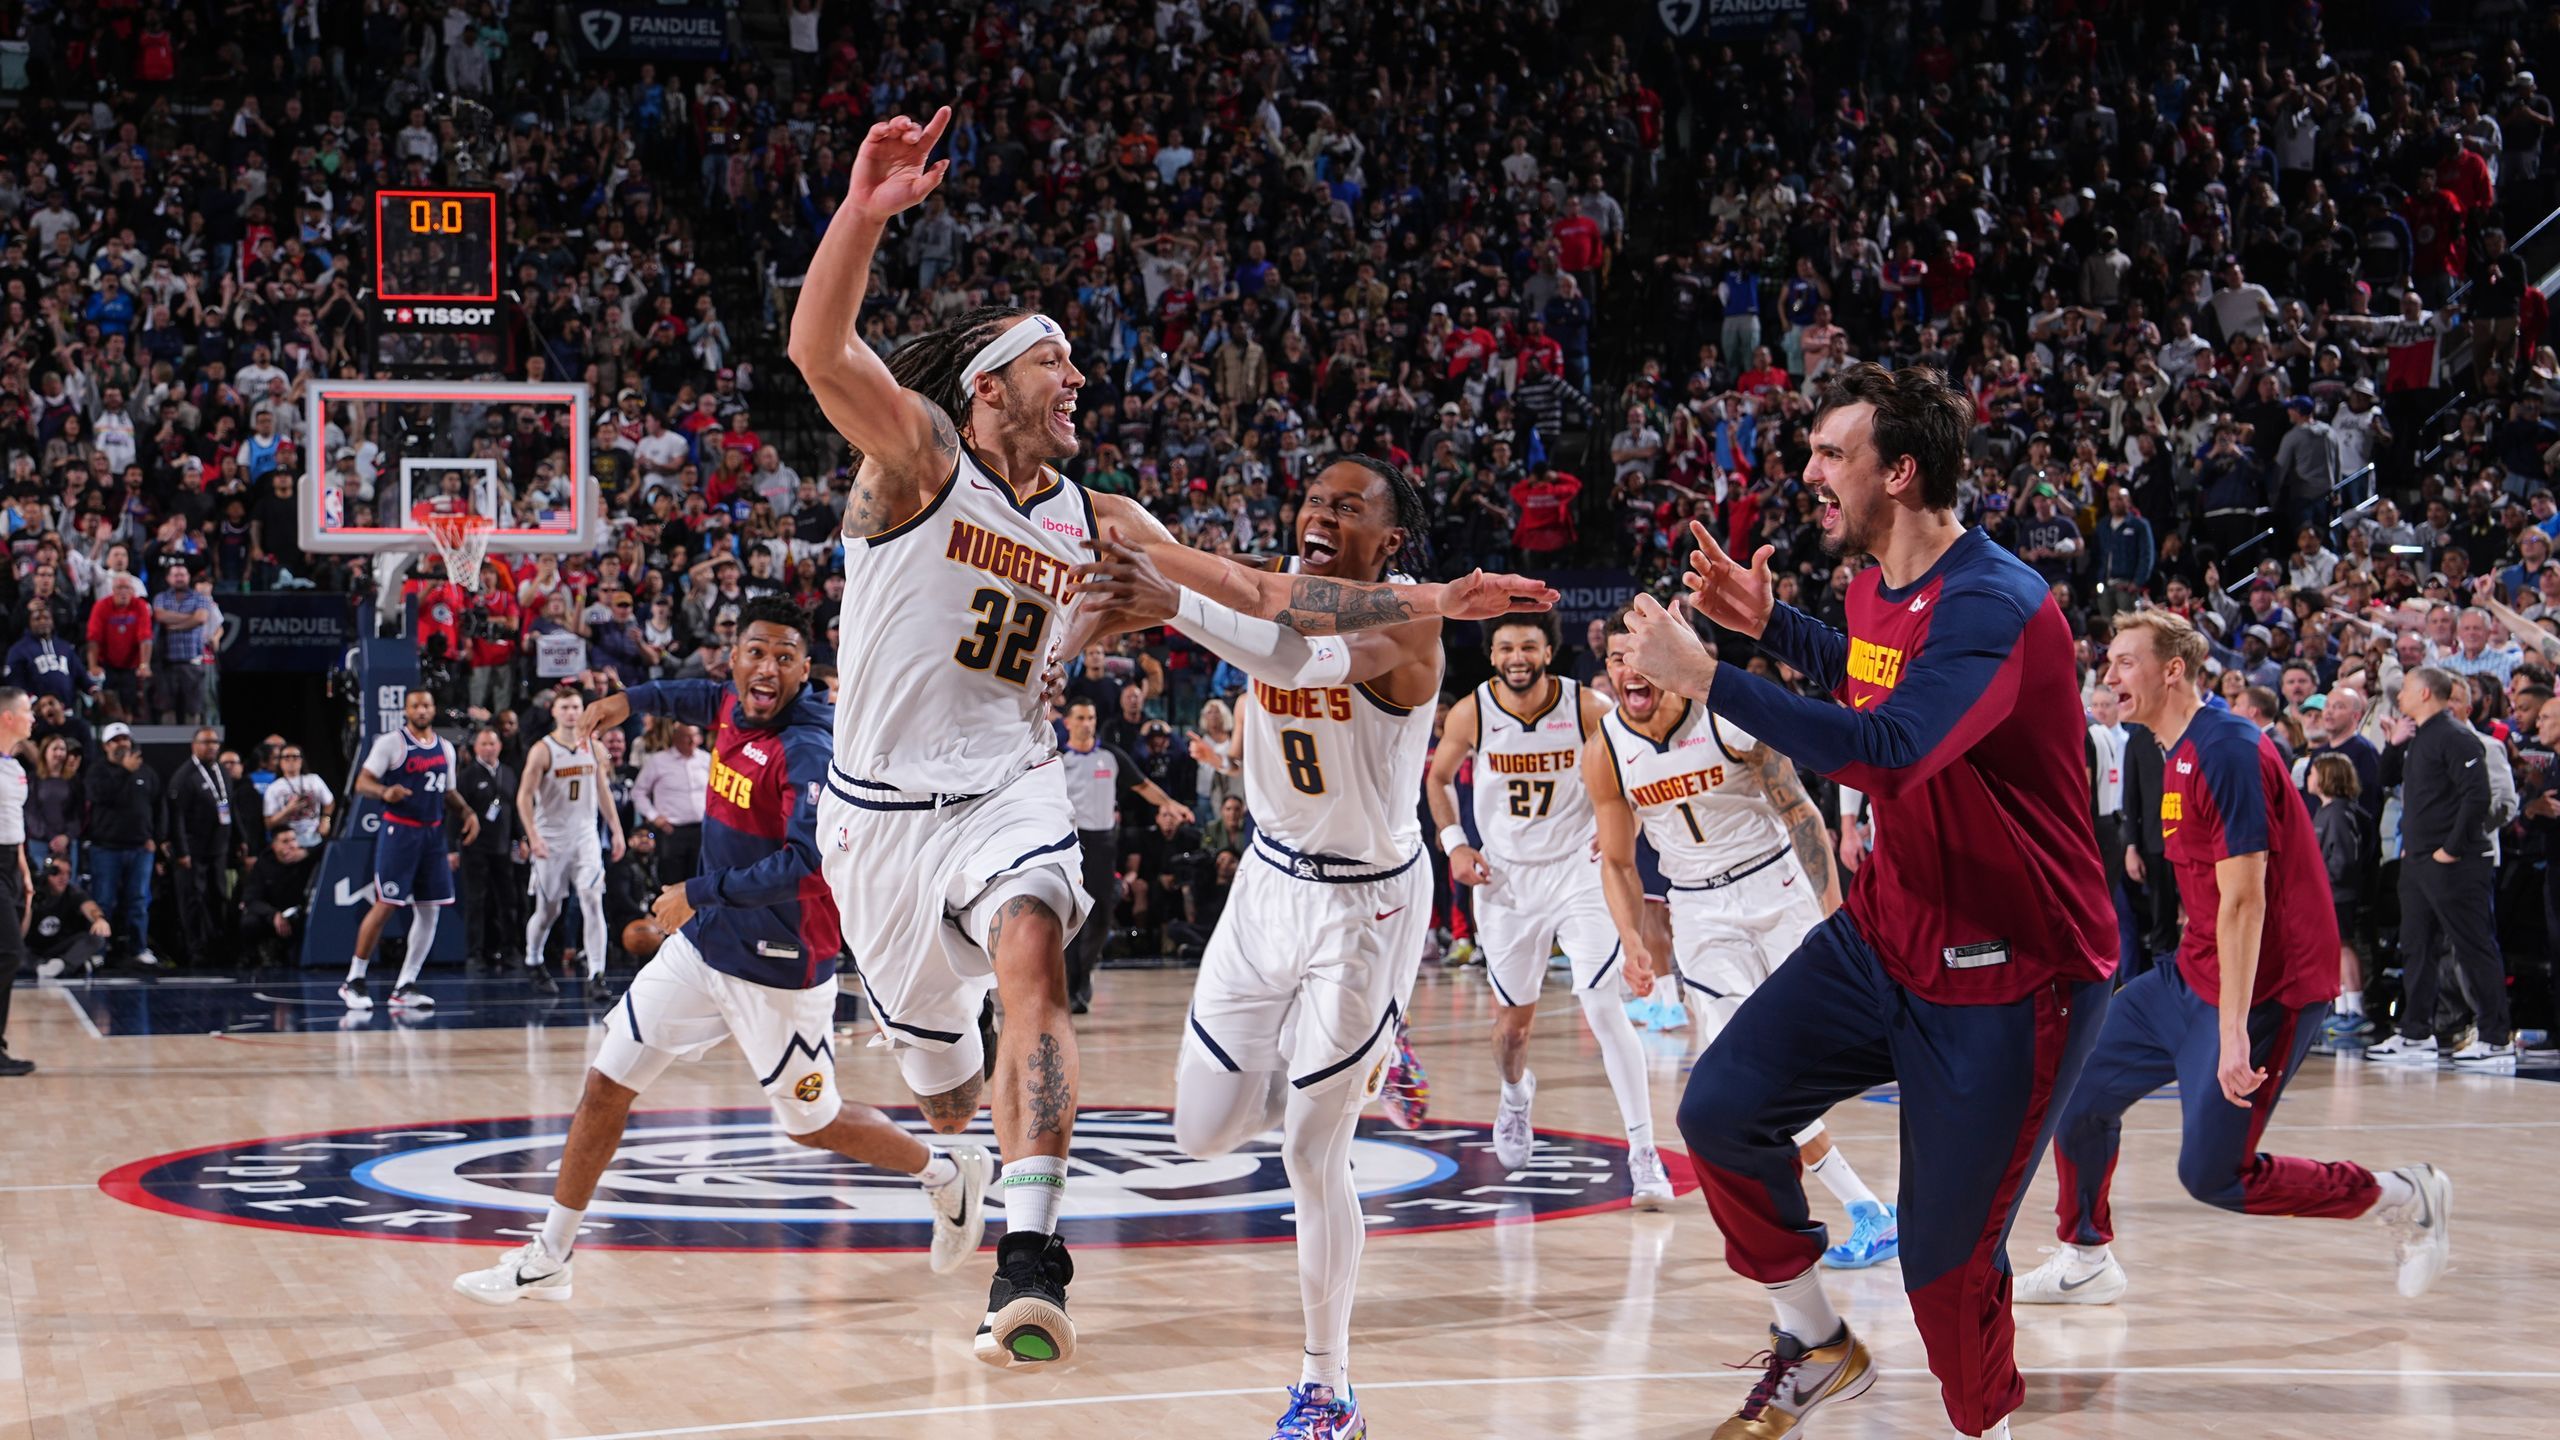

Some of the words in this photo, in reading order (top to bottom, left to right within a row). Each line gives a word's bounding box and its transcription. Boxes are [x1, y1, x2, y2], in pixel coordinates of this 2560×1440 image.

[629, 16, 722, 36] FANDUEL
[630, 36, 669, 47] SPORTS
[410, 200, 462, 233] 0.0
[414, 307, 495, 325] TISSOT
[1042, 517, 1083, 538] ibotta
[248, 616, 343, 635] FANDUEL
[953, 586, 1050, 688] 32
[378, 685, 408, 711] GET
[1281, 727, 1327, 796] 8
[1488, 749, 1575, 775] NUGGETS
[424, 771, 446, 794] 24
[1630, 764, 1726, 808] NUGGETS
[1508, 780, 1556, 819] 27
[1676, 802, 1707, 844] 1
